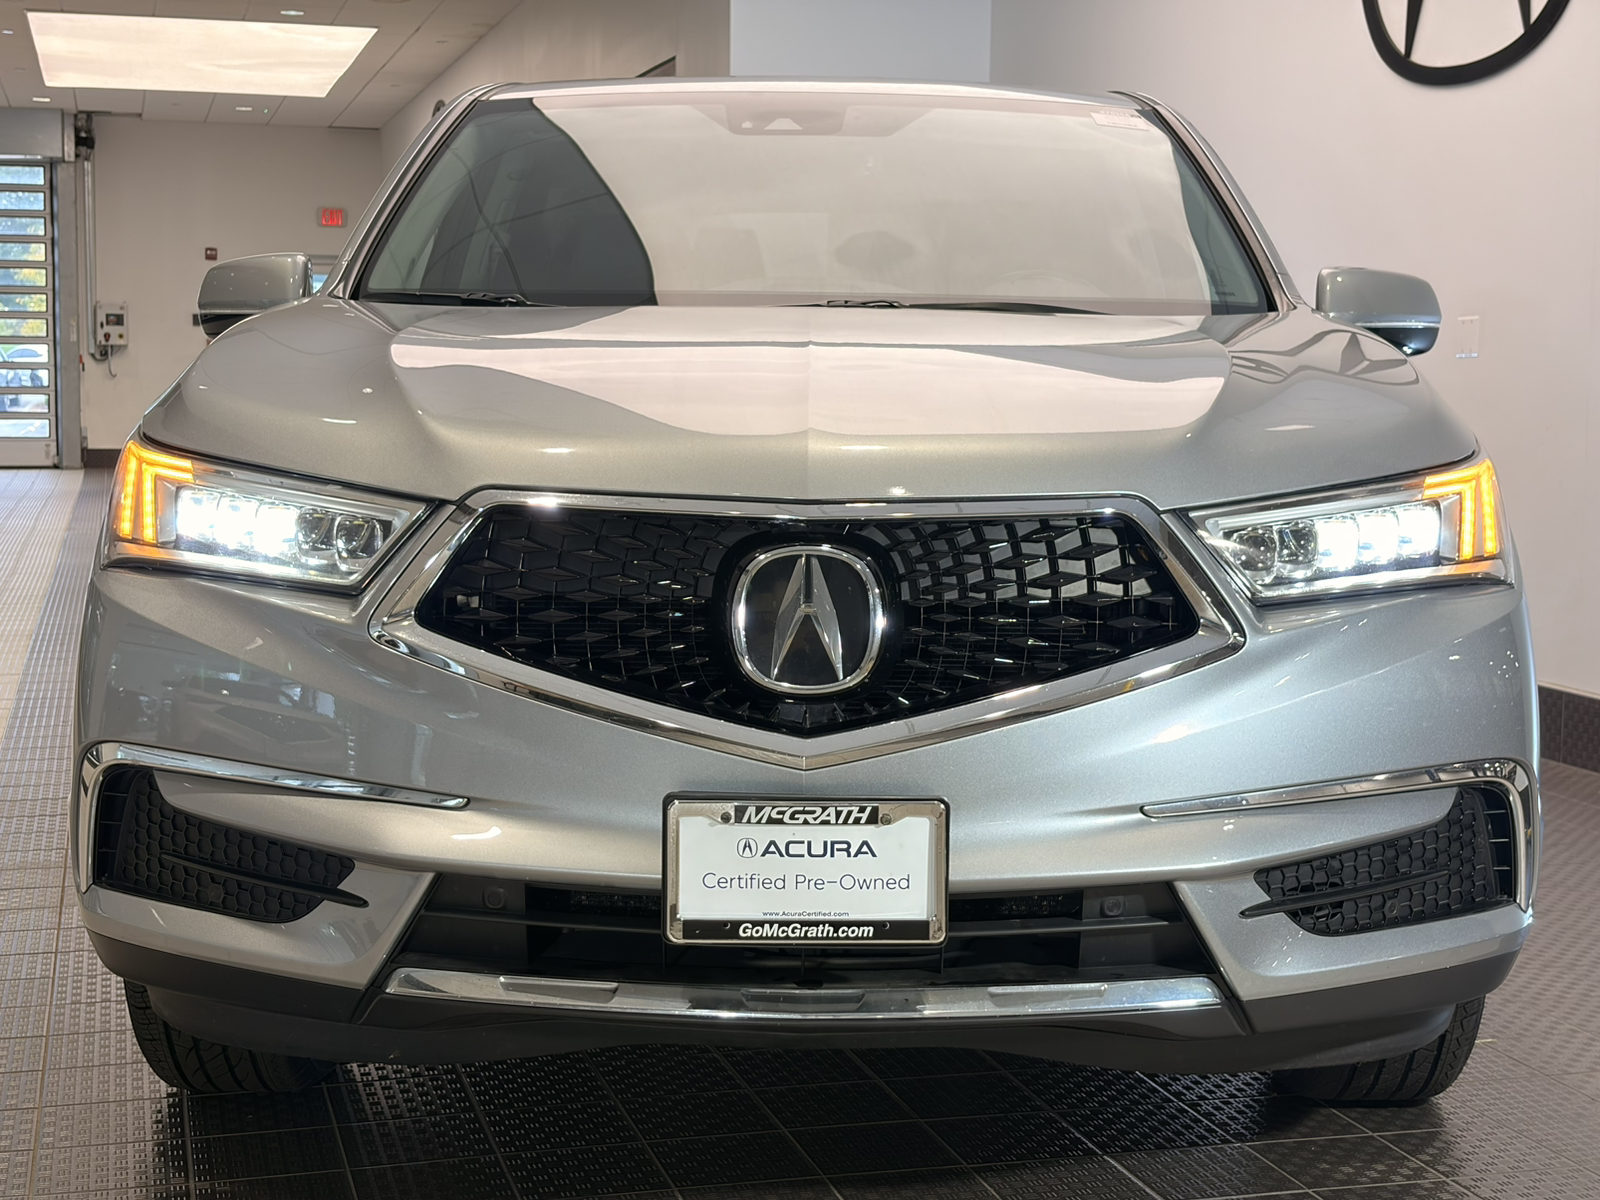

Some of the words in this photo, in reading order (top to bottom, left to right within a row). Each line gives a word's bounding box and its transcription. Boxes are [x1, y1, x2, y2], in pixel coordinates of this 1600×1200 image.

[760, 840, 877, 858] ACURA
[702, 872, 786, 889] Certified
[795, 873, 911, 890] Pre-Owned
[762, 910, 850, 918] www.AcuraCertified.com
[738, 922, 875, 938] GoMcGrath.com
